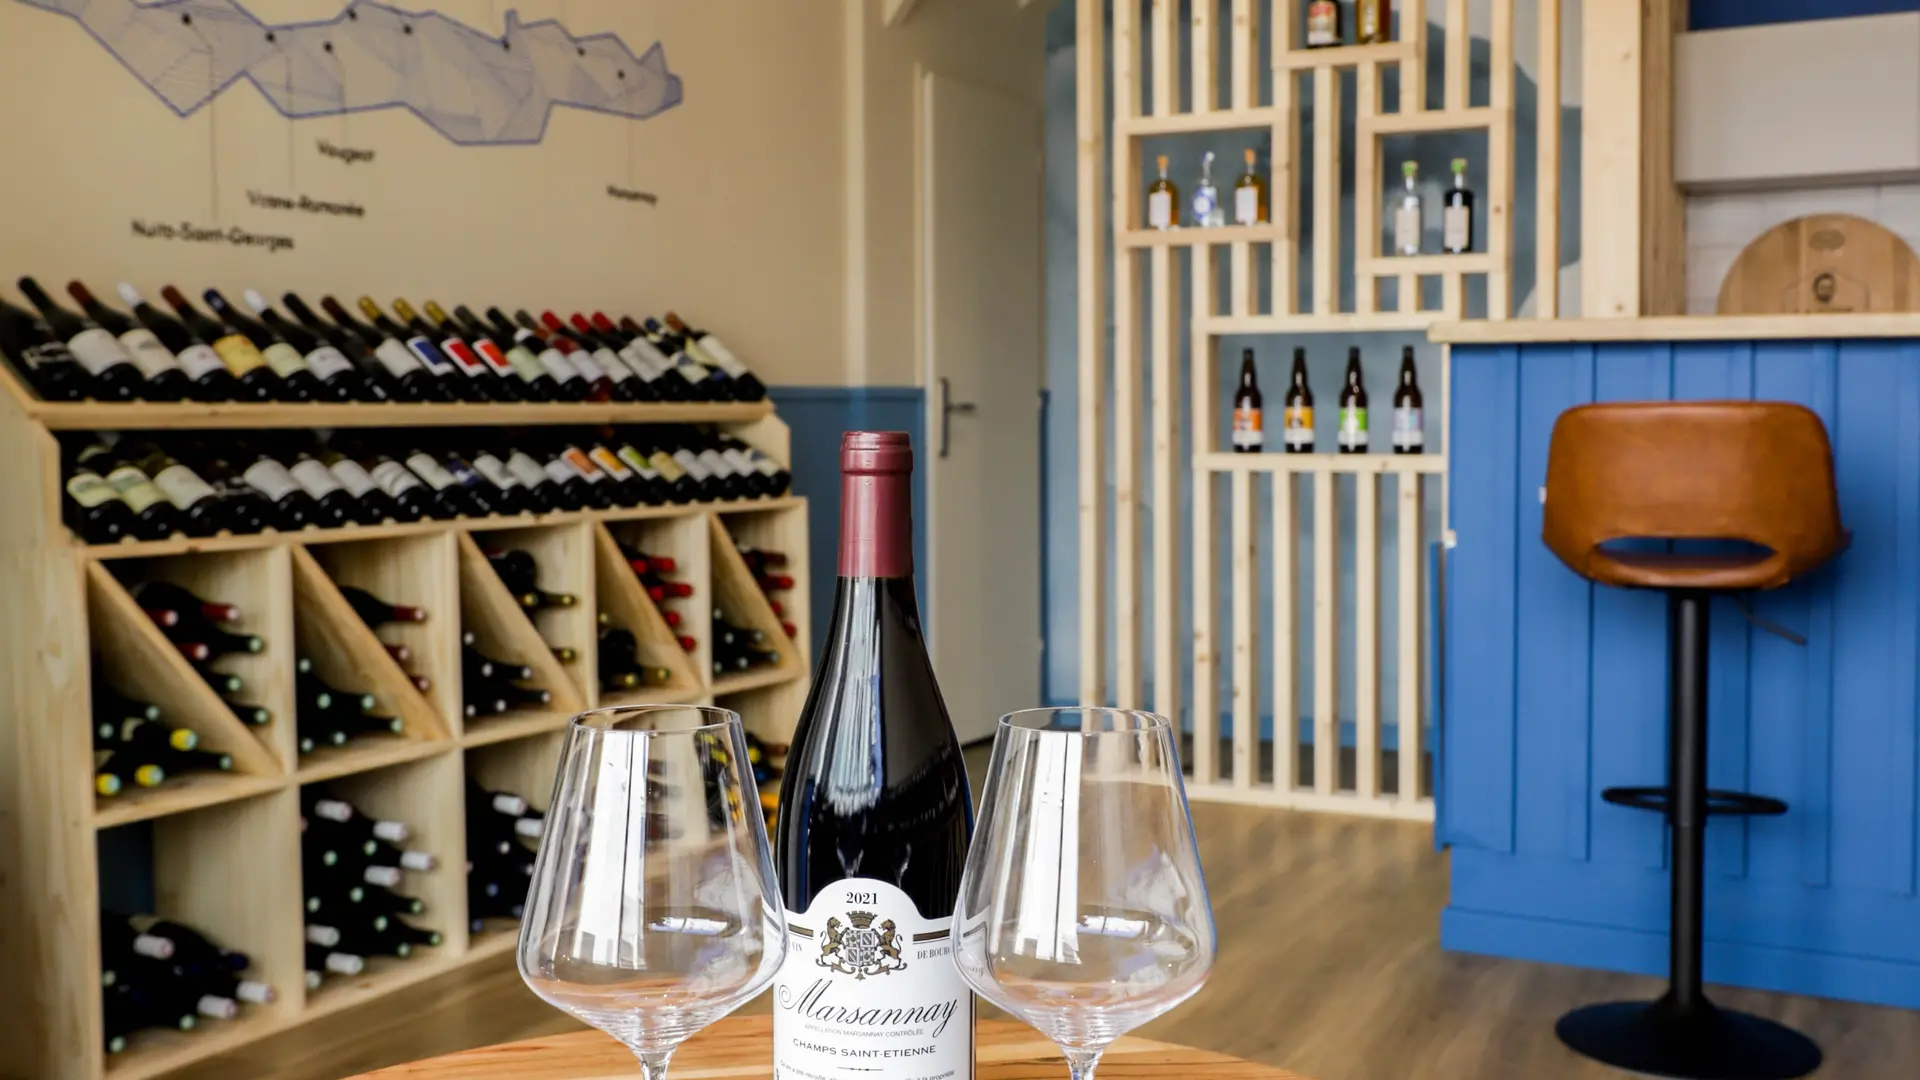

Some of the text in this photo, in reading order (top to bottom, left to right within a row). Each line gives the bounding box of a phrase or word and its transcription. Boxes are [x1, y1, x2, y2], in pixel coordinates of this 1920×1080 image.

[846, 892, 878, 905] 2021
[917, 950, 928, 960] DE
[779, 978, 958, 1038] Marsannay
[804, 1023, 924, 1038] APPELLATION MARSANNAY CONTRÔLÉE
[793, 1038, 936, 1058] CHAMPS SAINT-ETIENNE
